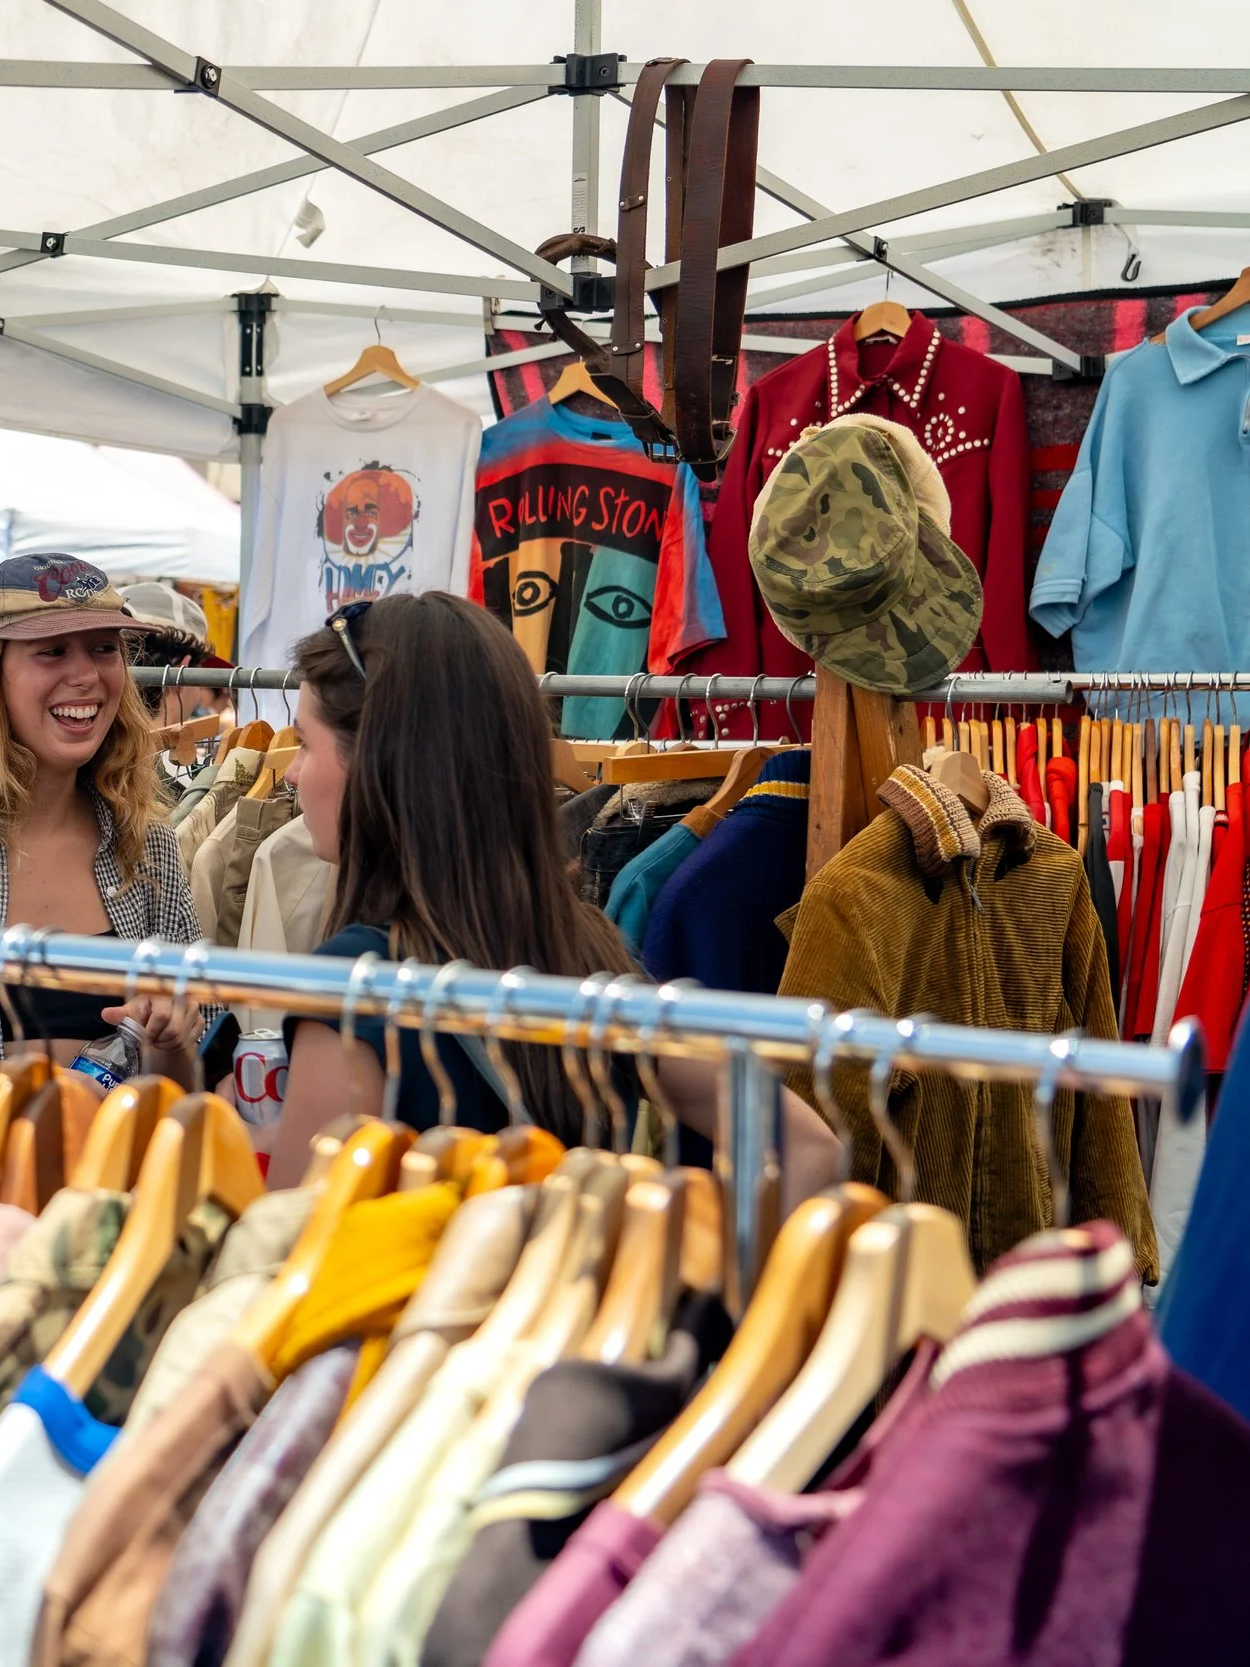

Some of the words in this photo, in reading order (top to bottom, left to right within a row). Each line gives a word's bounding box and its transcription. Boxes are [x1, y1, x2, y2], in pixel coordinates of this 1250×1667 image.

[488, 485, 589, 539] ROLLING
[65, 587, 96, 599] ROD
[235, 1051, 289, 1103] Co
